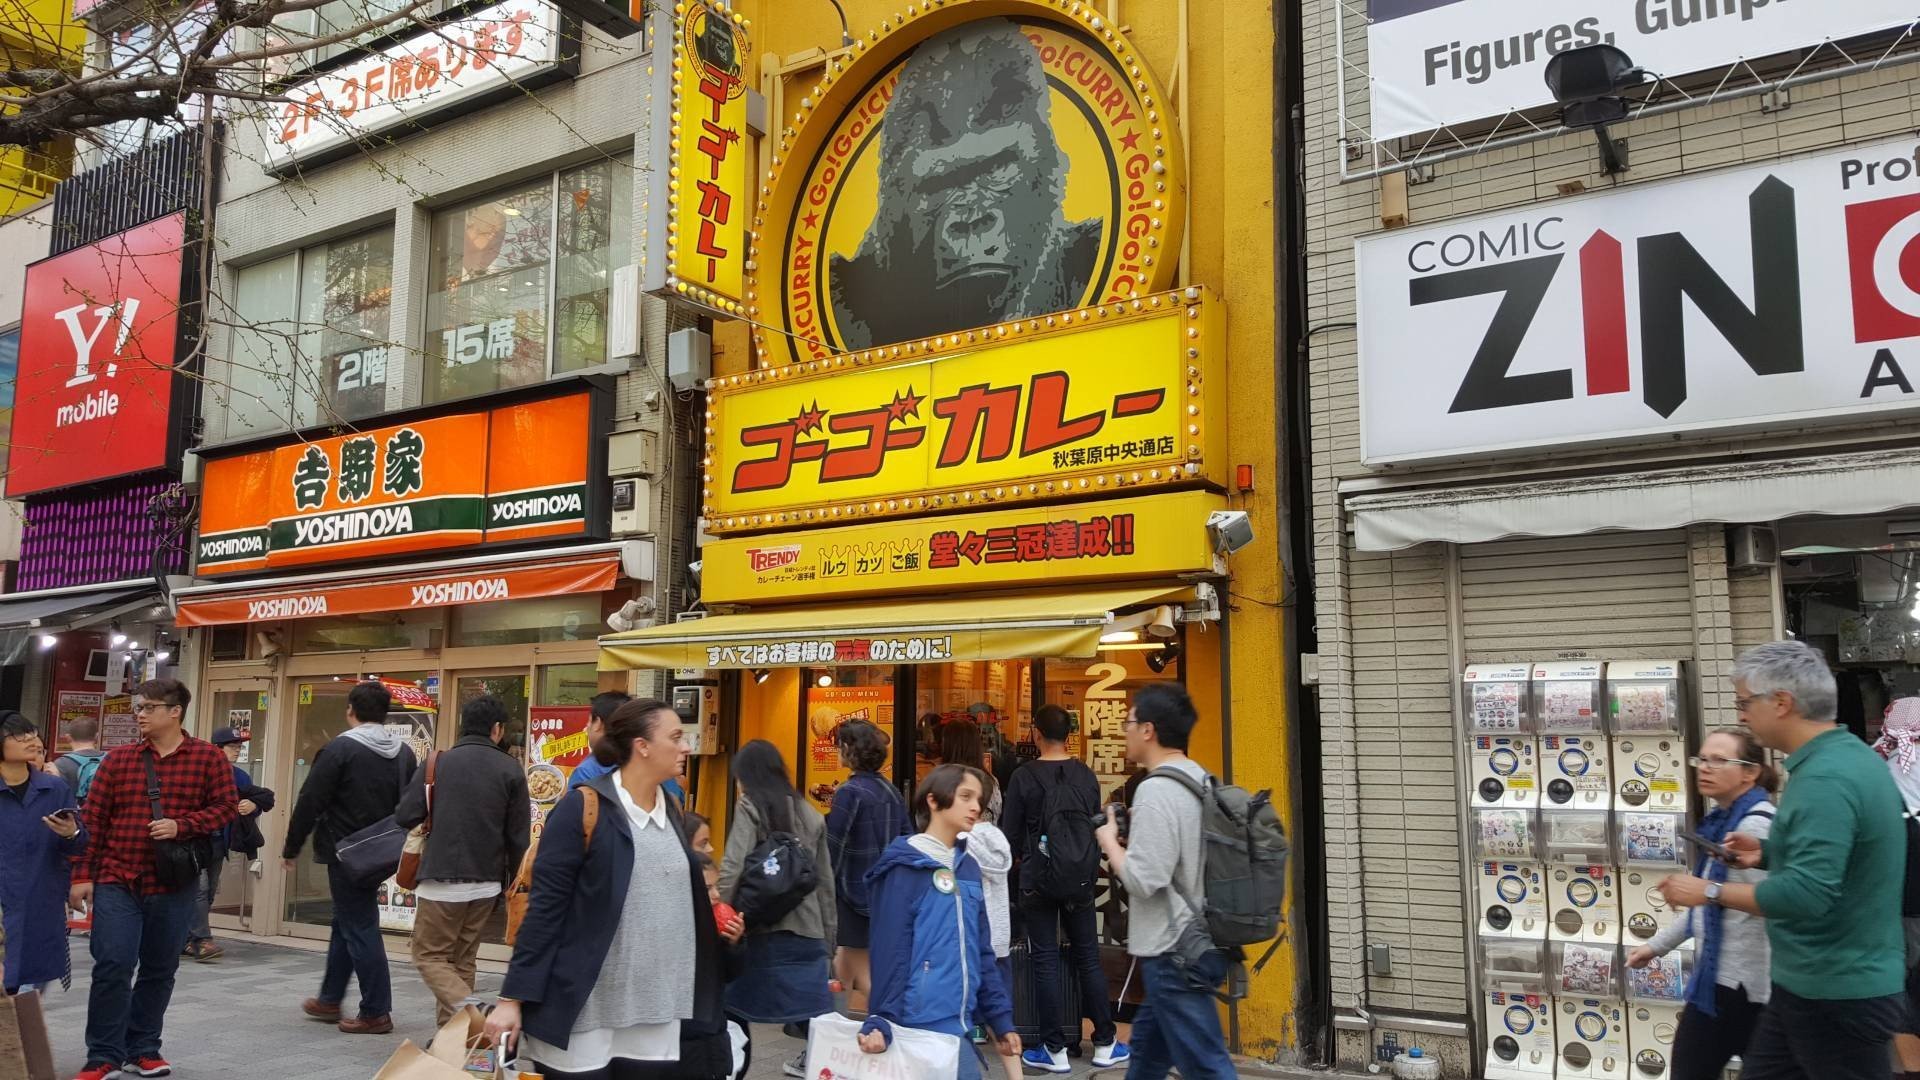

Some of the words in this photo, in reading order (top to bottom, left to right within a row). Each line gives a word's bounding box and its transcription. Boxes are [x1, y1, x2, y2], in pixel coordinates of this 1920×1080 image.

[1423, 16, 1615, 86] Figures,
[1408, 216, 1564, 273] COMIC
[1409, 173, 1805, 419] ZIN
[54, 297, 140, 388] Y!
[443, 317, 516, 368] 15席
[337, 347, 387, 392] 2階
[56, 389, 119, 428] mobile
[731, 370, 1167, 494] ゴーゴーカレー
[1053, 436, 1175, 470] 秋葉原中央通店
[294, 505, 413, 547] YOSHINOYA
[492, 493, 582, 522] YOSHINOYA
[200, 535, 263, 558] YOSHINOYA
[746, 549, 800, 571] TRENDY
[856, 557, 883, 574] カツ
[248, 595, 327, 619] YOSHINOYA
[411, 579, 509, 605] YOSHINOYA
[706, 636, 953, 667] すべてはお客様の元気のために!
